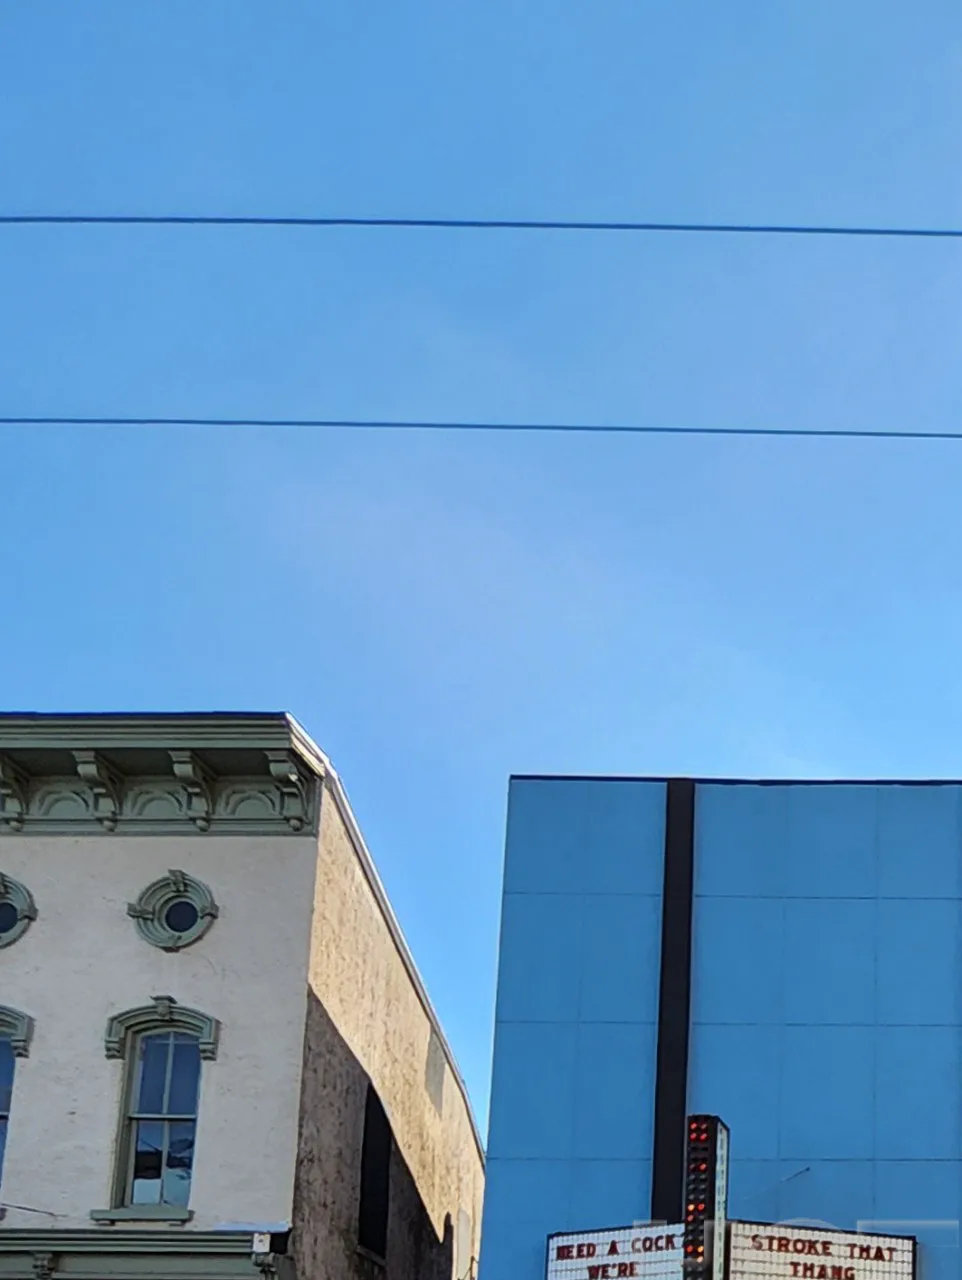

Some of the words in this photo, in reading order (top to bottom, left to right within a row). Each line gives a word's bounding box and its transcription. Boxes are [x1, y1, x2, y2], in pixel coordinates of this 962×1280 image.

[556, 1242, 597, 1260] NEED
[607, 1240, 620, 1256] A
[631, 1233, 676, 1254] COCK
[751, 1234, 833, 1256] STROKE
[846, 1243, 897, 1262] THAT
[587, 1261, 639, 1280] WE'RE
